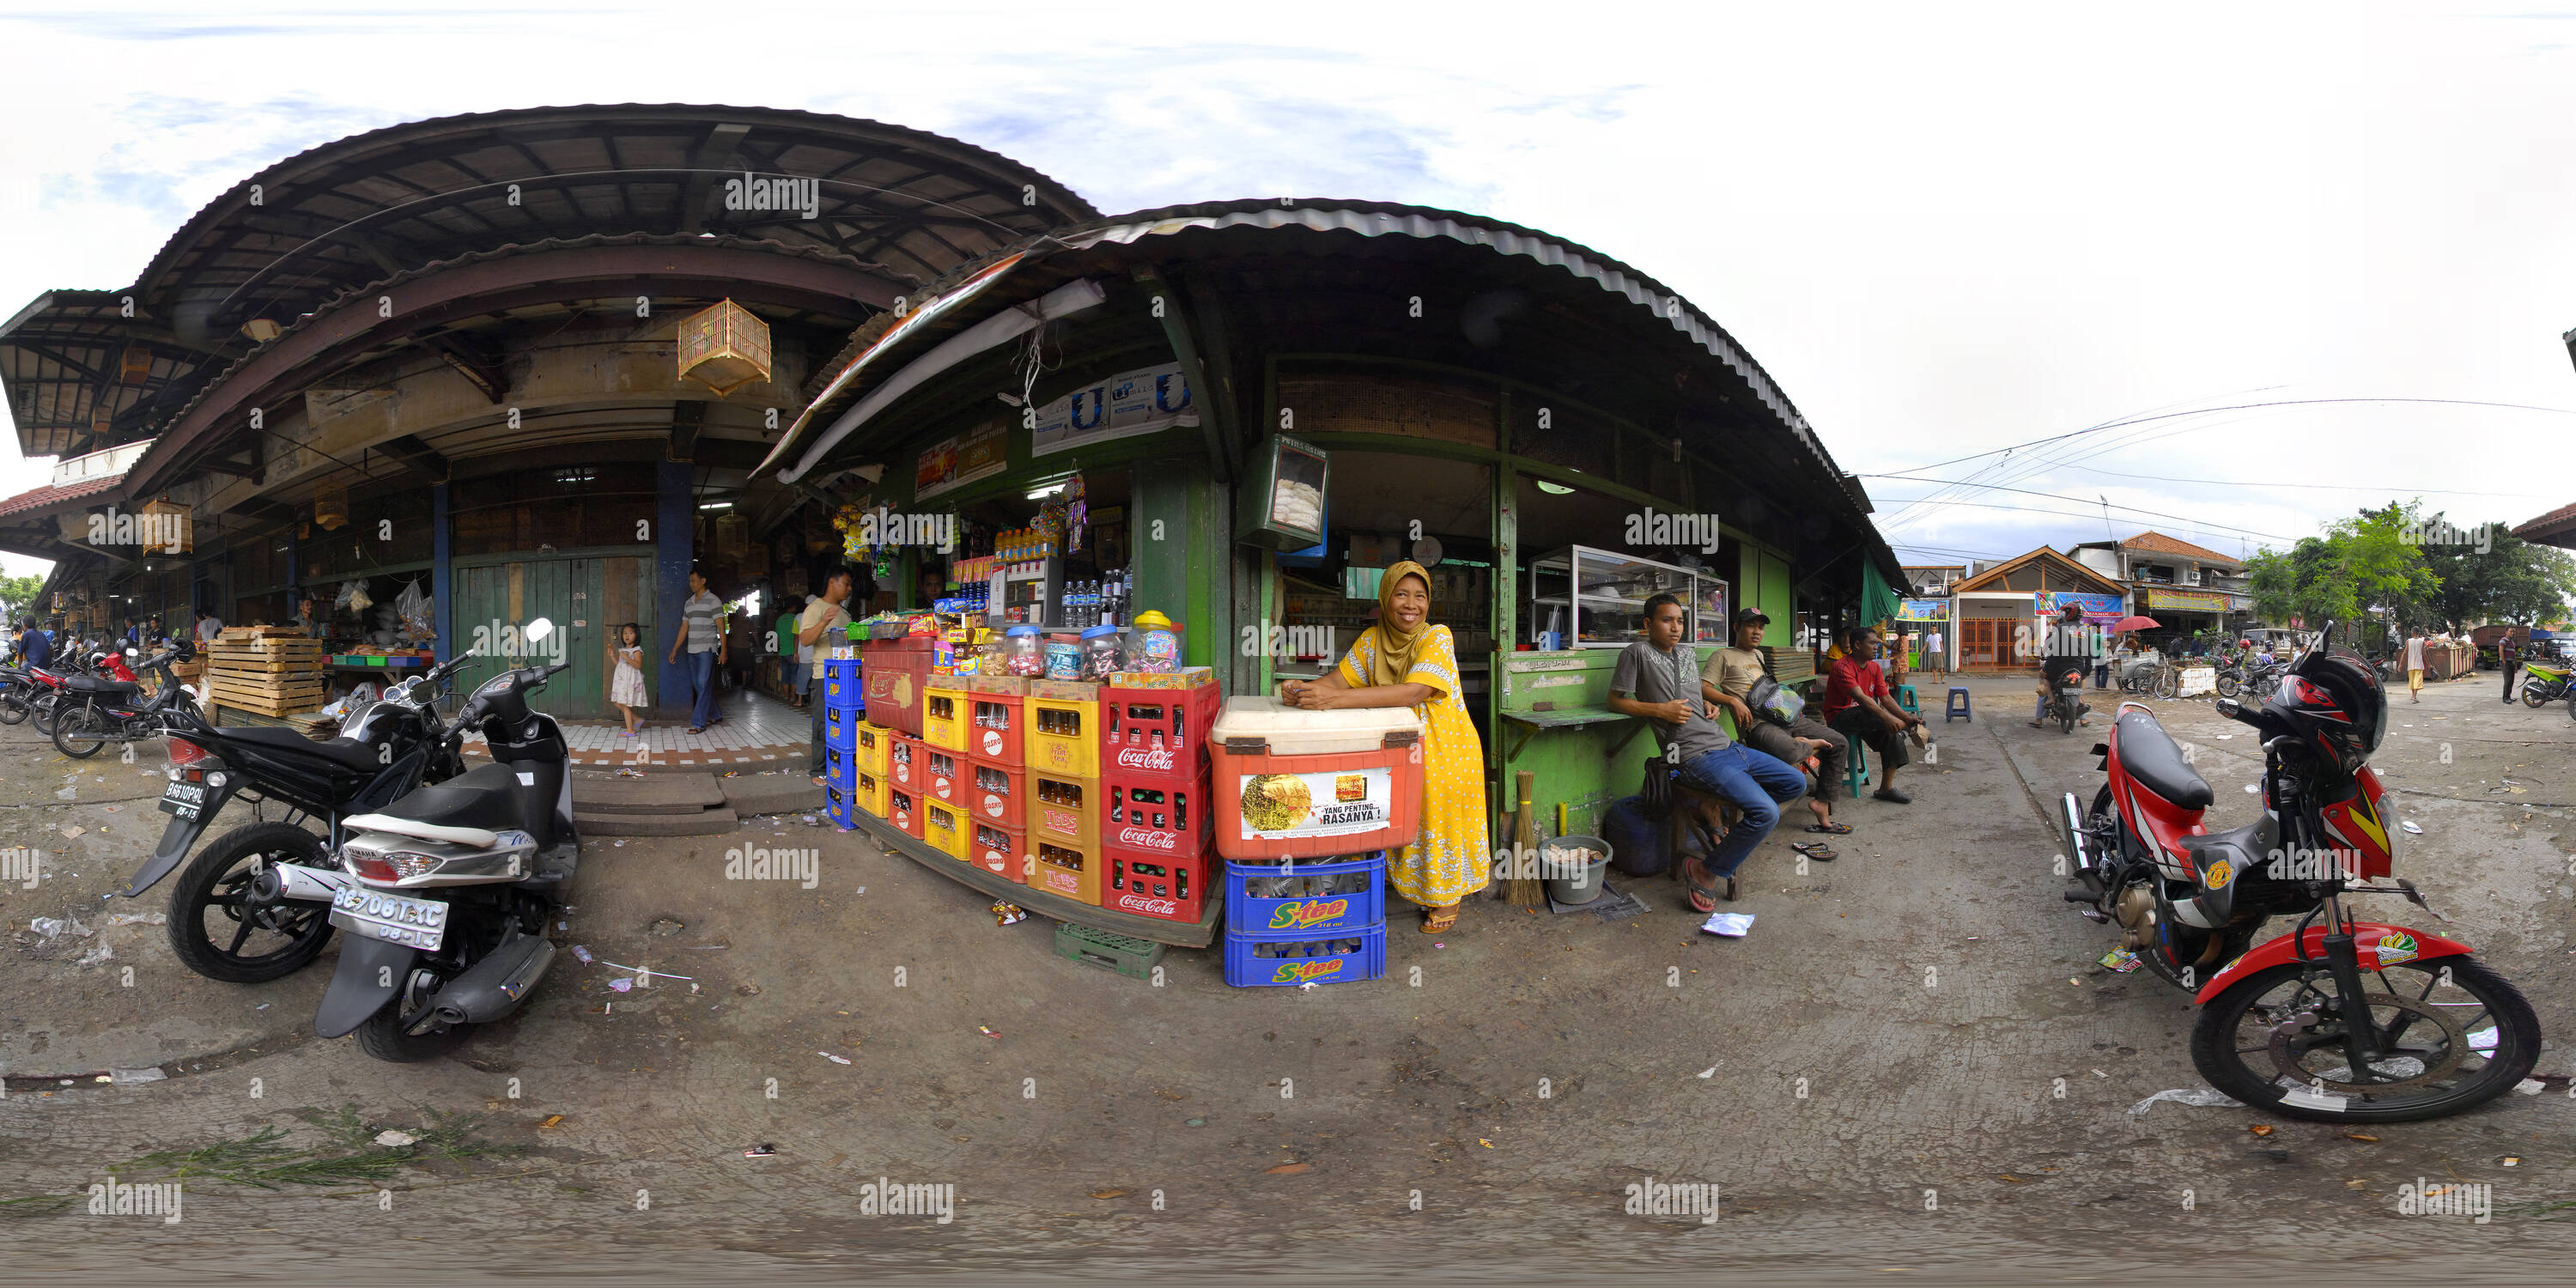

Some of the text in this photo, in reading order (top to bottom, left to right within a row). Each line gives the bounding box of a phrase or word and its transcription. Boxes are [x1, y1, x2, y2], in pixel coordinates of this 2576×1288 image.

[983, 738, 1001, 749] SOSRO
[984, 801, 1002, 810] SOSRO
[1323, 810, 1374, 825] RASANYA
[348, 848, 377, 859] YAMAHA
[1267, 898, 1348, 929] S-tee
[1272, 958, 1344, 983] S-tee
